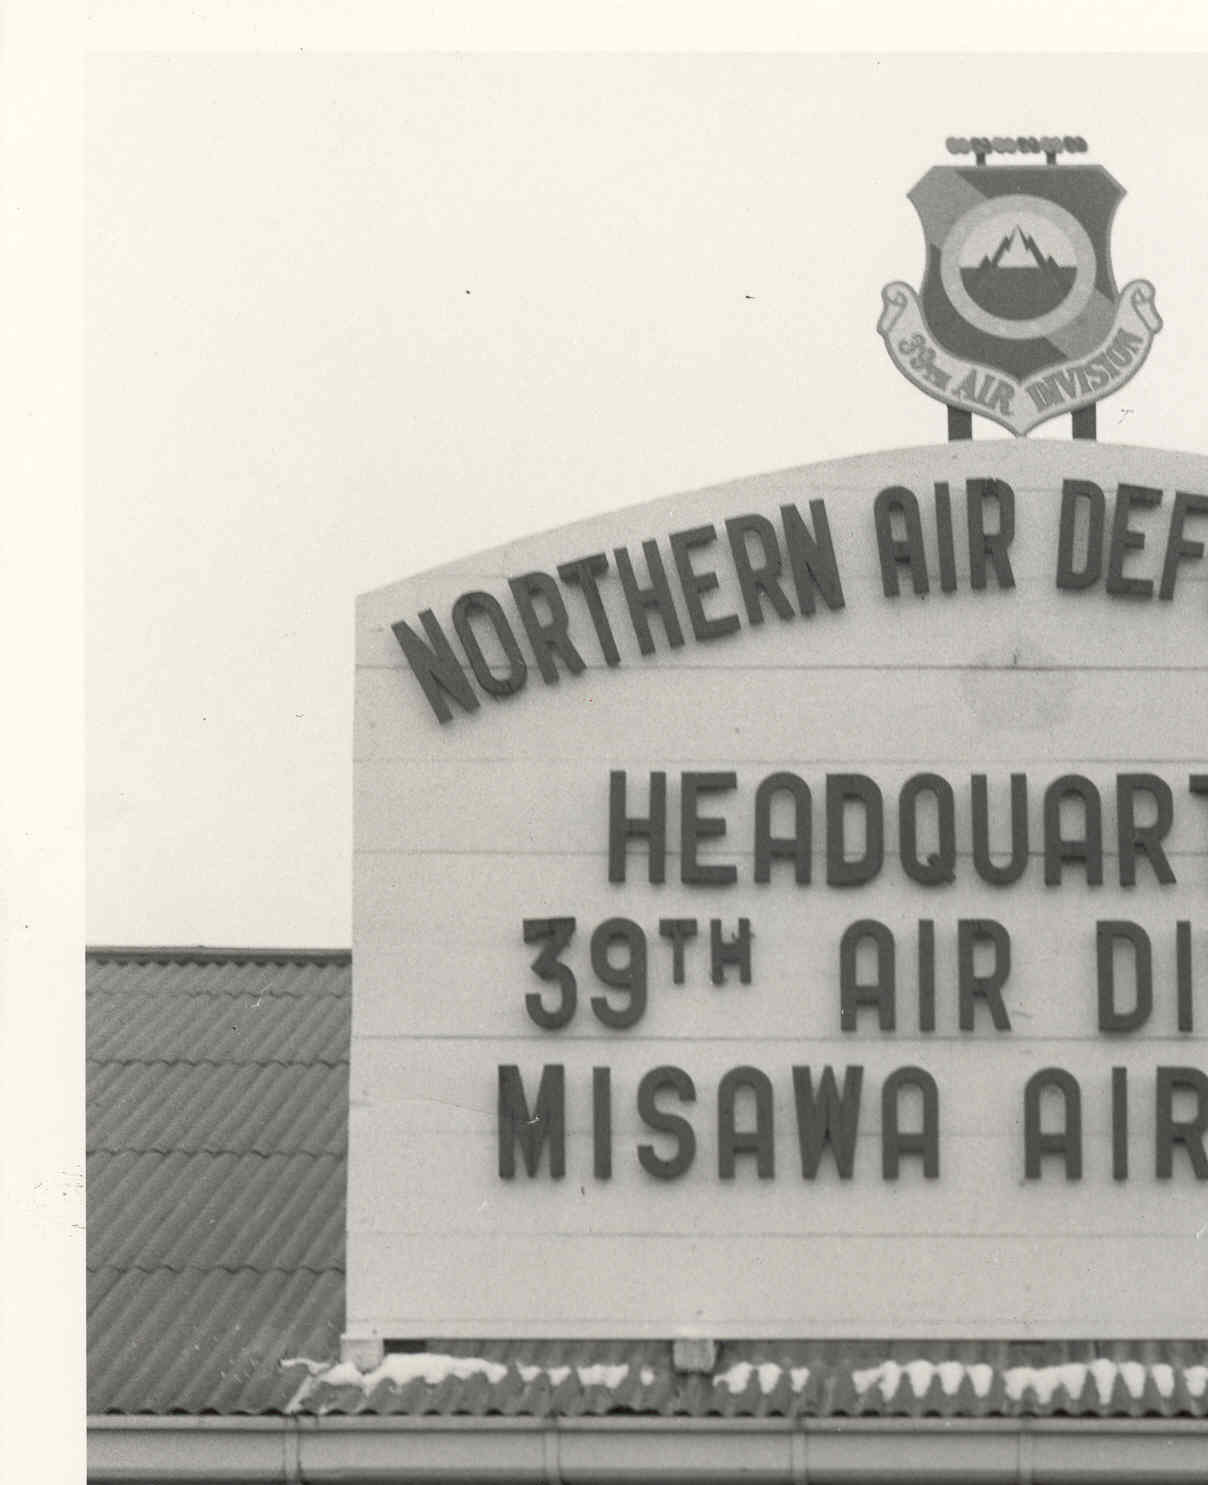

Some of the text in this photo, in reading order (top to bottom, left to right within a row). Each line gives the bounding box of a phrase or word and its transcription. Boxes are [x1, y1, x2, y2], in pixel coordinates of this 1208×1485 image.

[952, 368, 1015, 416] AIR
[1025, 328, 1144, 412] DIVISION
[391, 498, 847, 726] NORTHERN
[873, 477, 1017, 604] AIR
[522, 916, 755, 1039] 39TH
[839, 918, 1012, 1040] AIR
[496, 1063, 941, 1185] MISAWA
